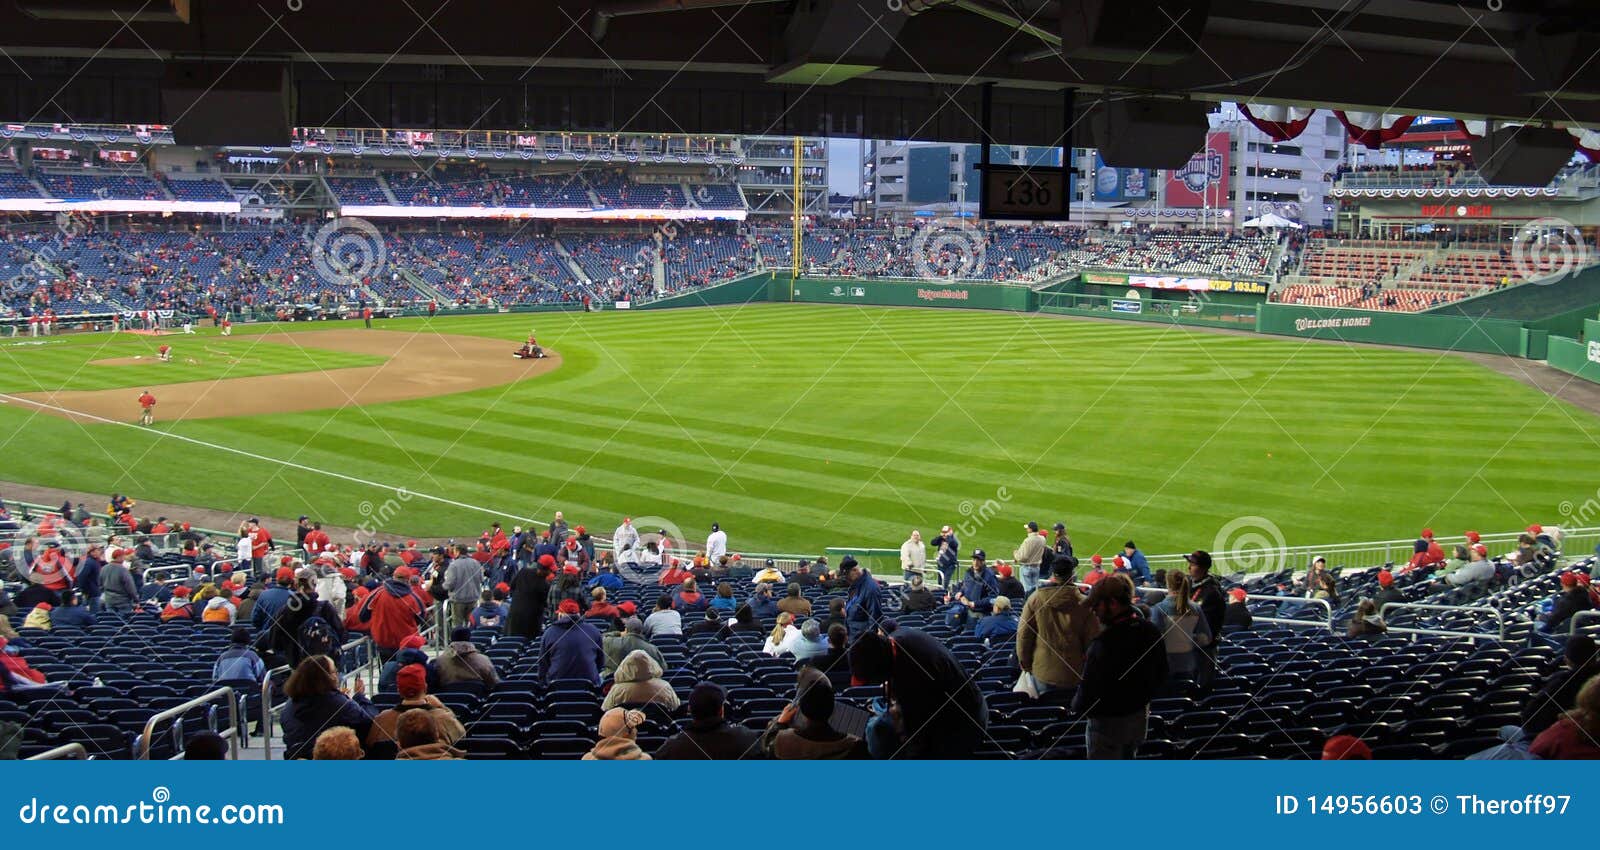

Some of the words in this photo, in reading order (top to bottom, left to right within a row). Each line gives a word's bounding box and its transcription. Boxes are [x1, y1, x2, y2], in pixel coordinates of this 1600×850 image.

[1003, 180, 1051, 206] 136
[1295, 317, 1341, 331] WELCOME
[1342, 317, 1371, 327] HOME!
